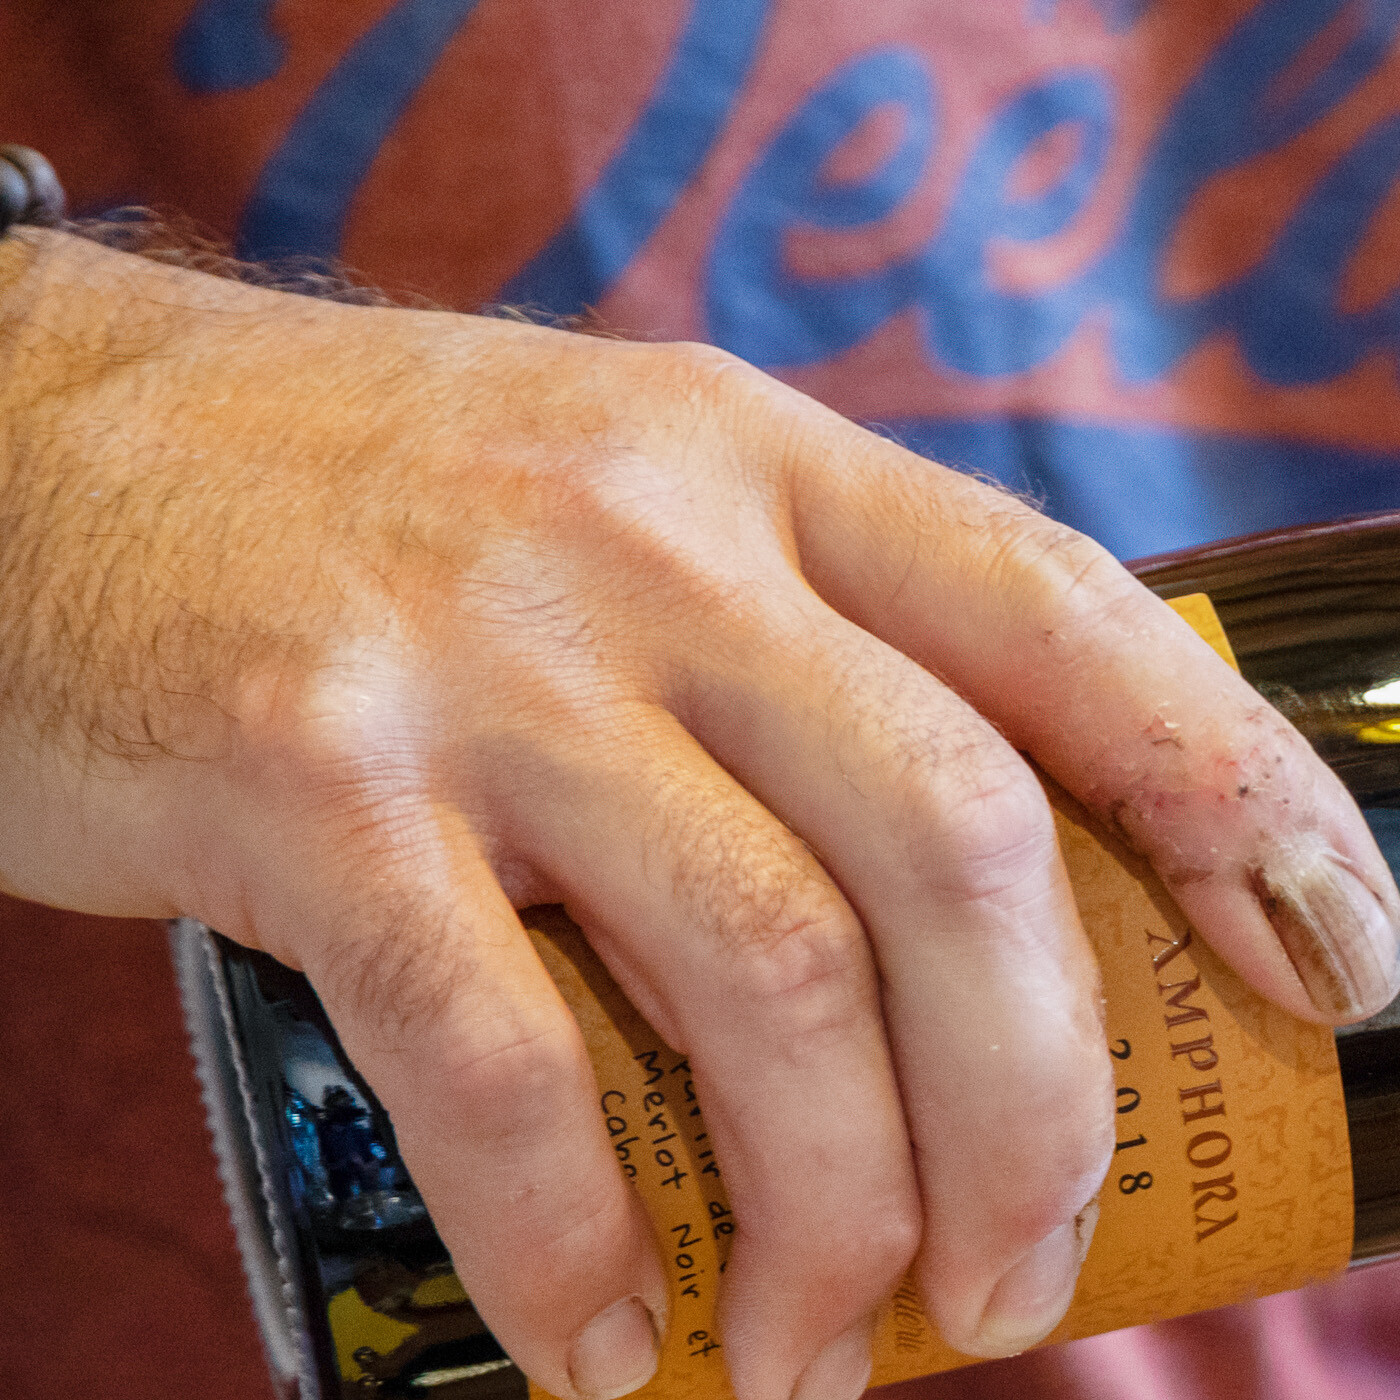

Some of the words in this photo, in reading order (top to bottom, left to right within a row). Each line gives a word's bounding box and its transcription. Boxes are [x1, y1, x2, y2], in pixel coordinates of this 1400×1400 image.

[634, 1050, 688, 1190] Merlot
[1109, 1038, 1154, 1196] 2018
[1144, 927, 1239, 1244] AMPHORA
[670, 1223, 703, 1298] Noir
[707, 1201, 736, 1241] de
[686, 1329, 722, 1358] et
